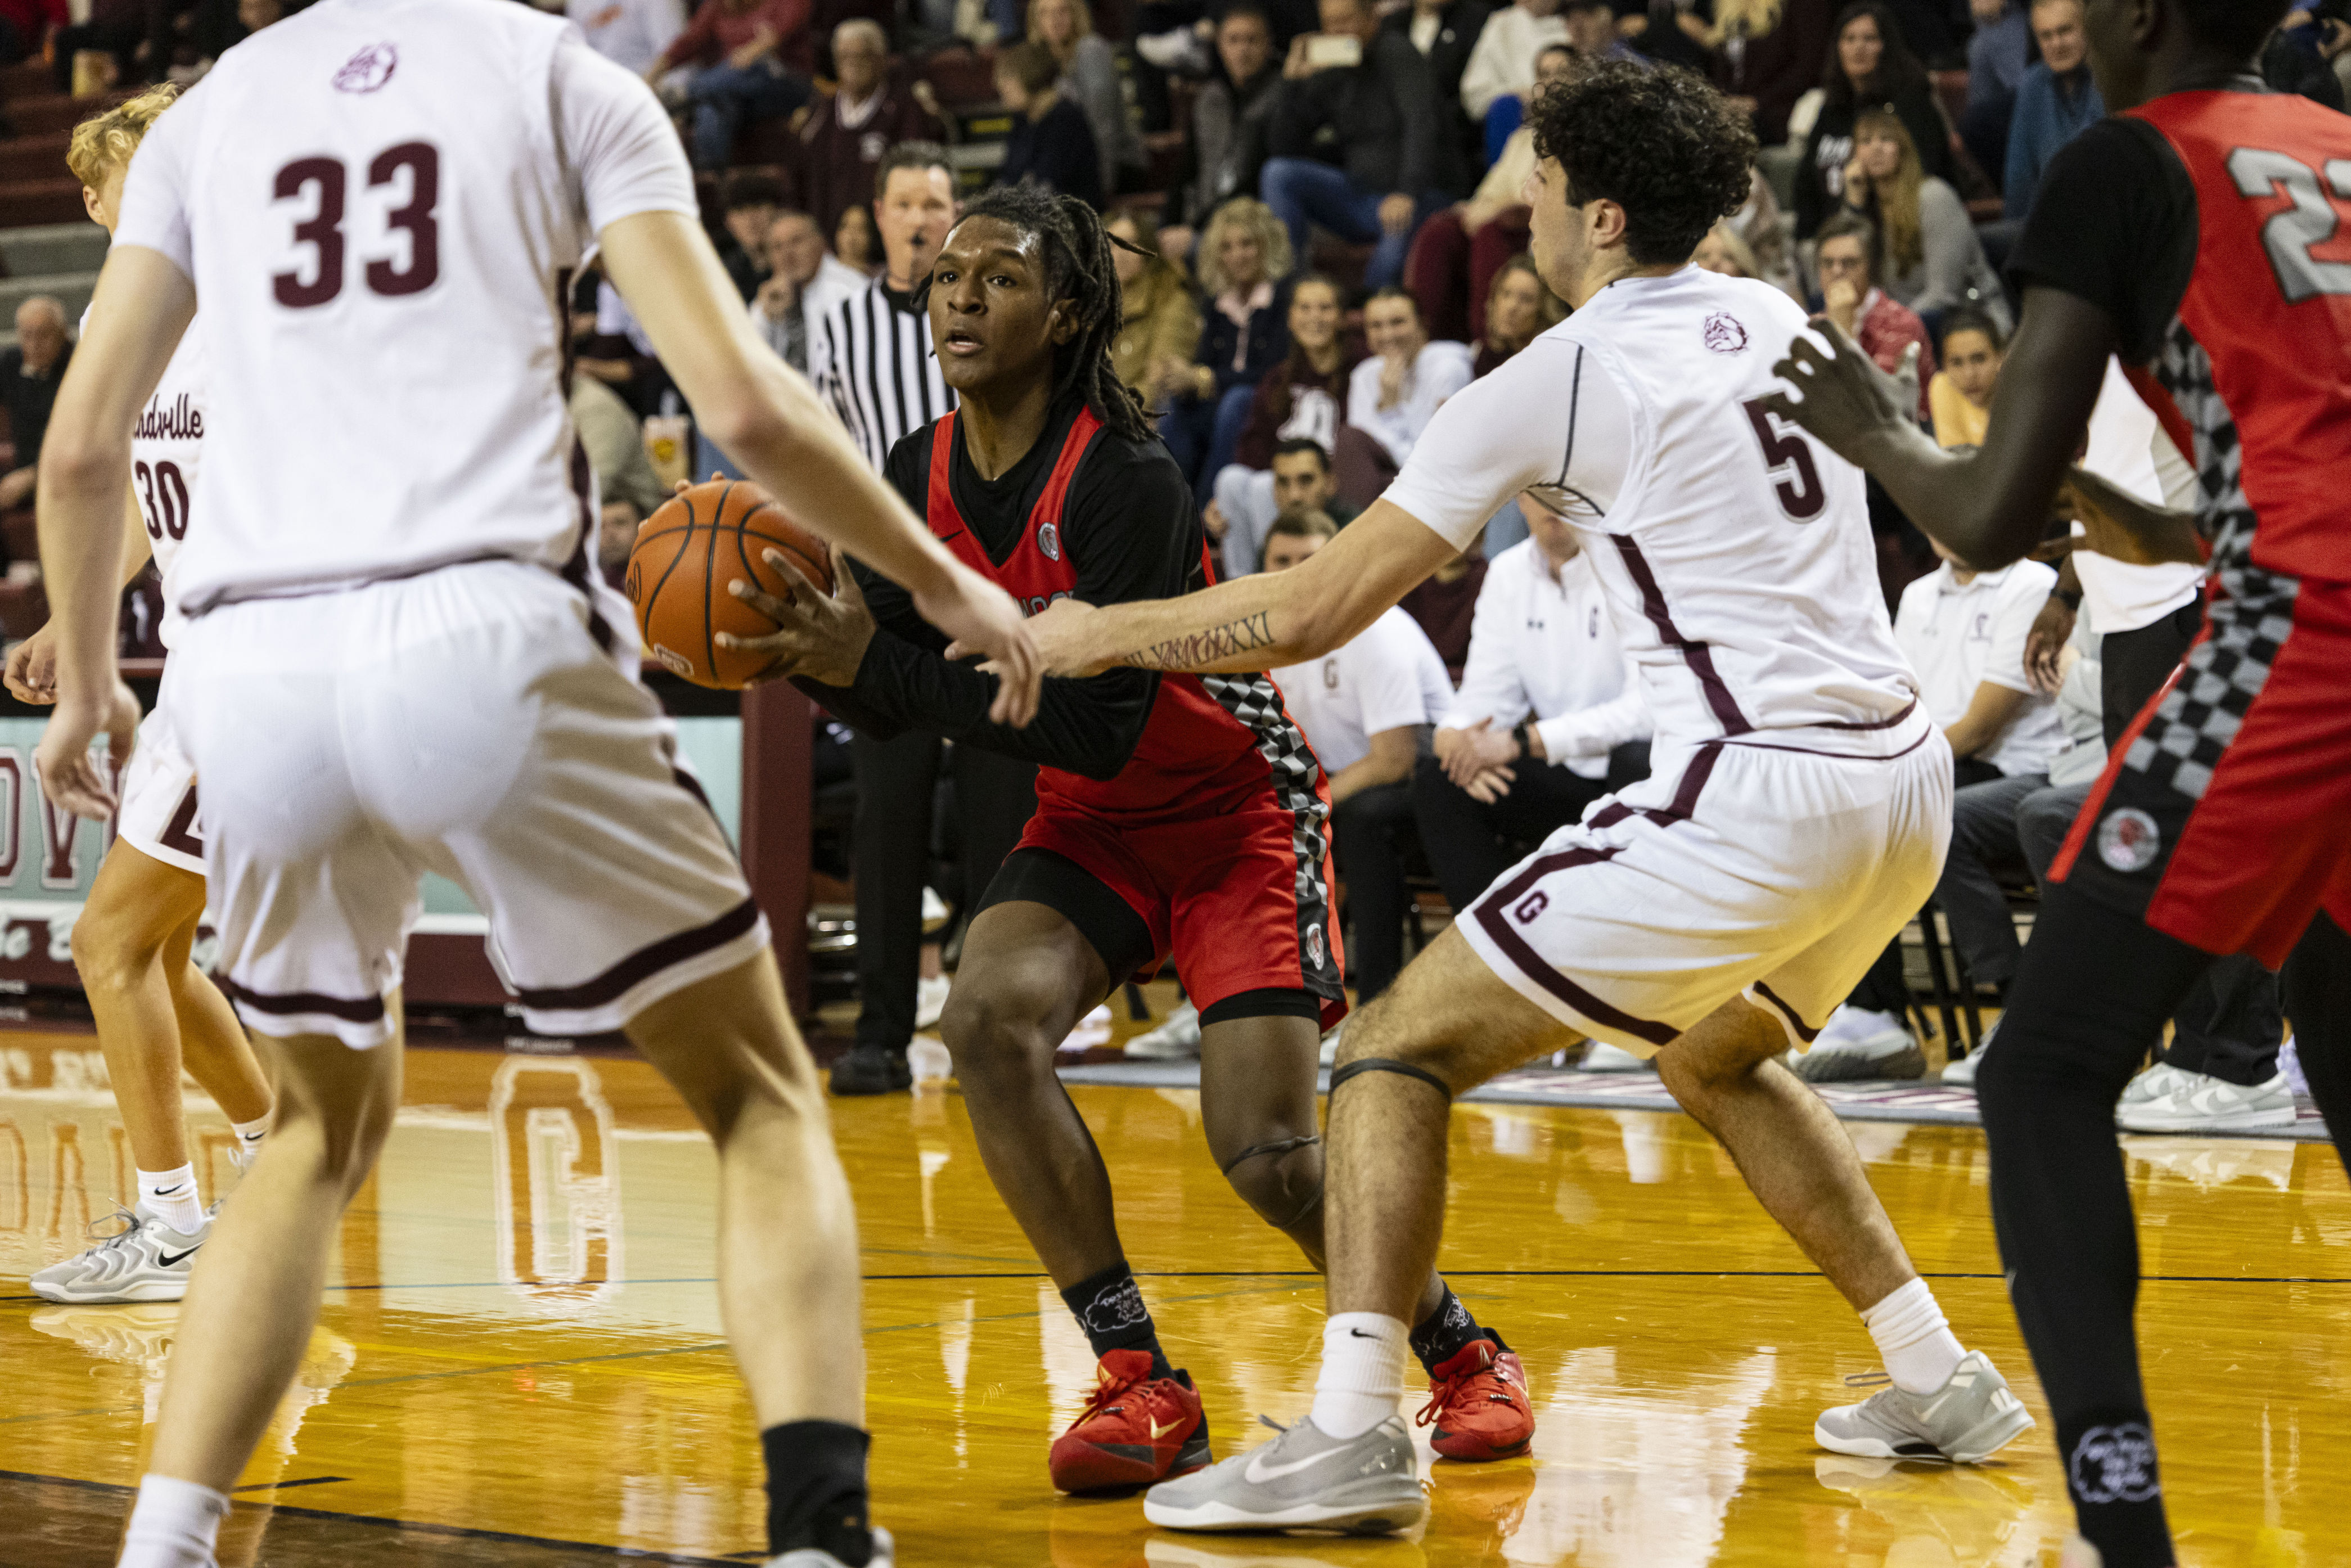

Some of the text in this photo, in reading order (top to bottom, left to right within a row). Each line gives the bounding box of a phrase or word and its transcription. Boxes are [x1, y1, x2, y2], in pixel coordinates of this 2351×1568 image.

[272, 141, 439, 309] 33
[135, 460, 190, 541] 30
[1740, 391, 1827, 521] 5
[1514, 890, 1548, 925] G
